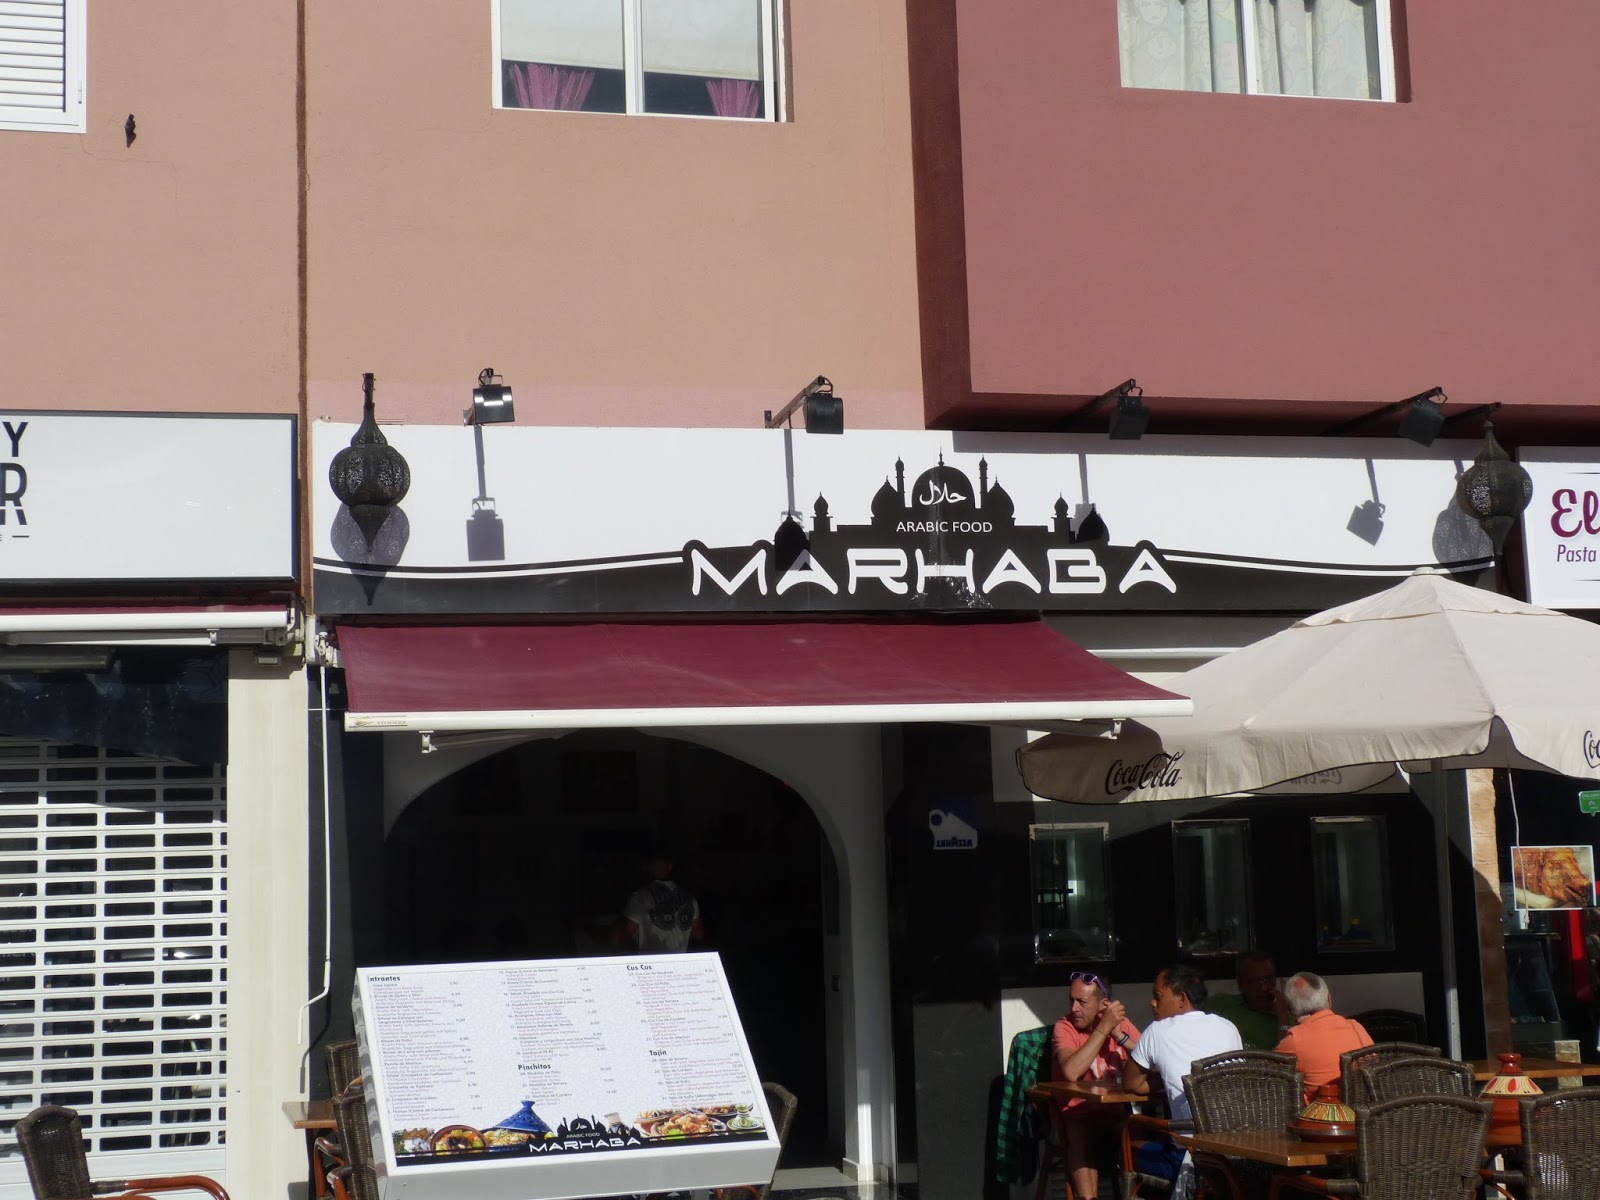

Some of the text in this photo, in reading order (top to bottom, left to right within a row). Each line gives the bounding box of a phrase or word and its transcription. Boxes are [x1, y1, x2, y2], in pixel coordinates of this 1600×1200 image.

[919, 479, 967, 505] حلال
[896, 521, 993, 533] ARABIC FOOD
[1557, 544, 1597, 562] Pasta
[691, 548, 1177, 596] MARHABA
[1105, 751, 1185, 795] Coca-Cola
[517, 1063, 552, 1071] Pinchitos
[529, 1137, 641, 1153] MARHABA
